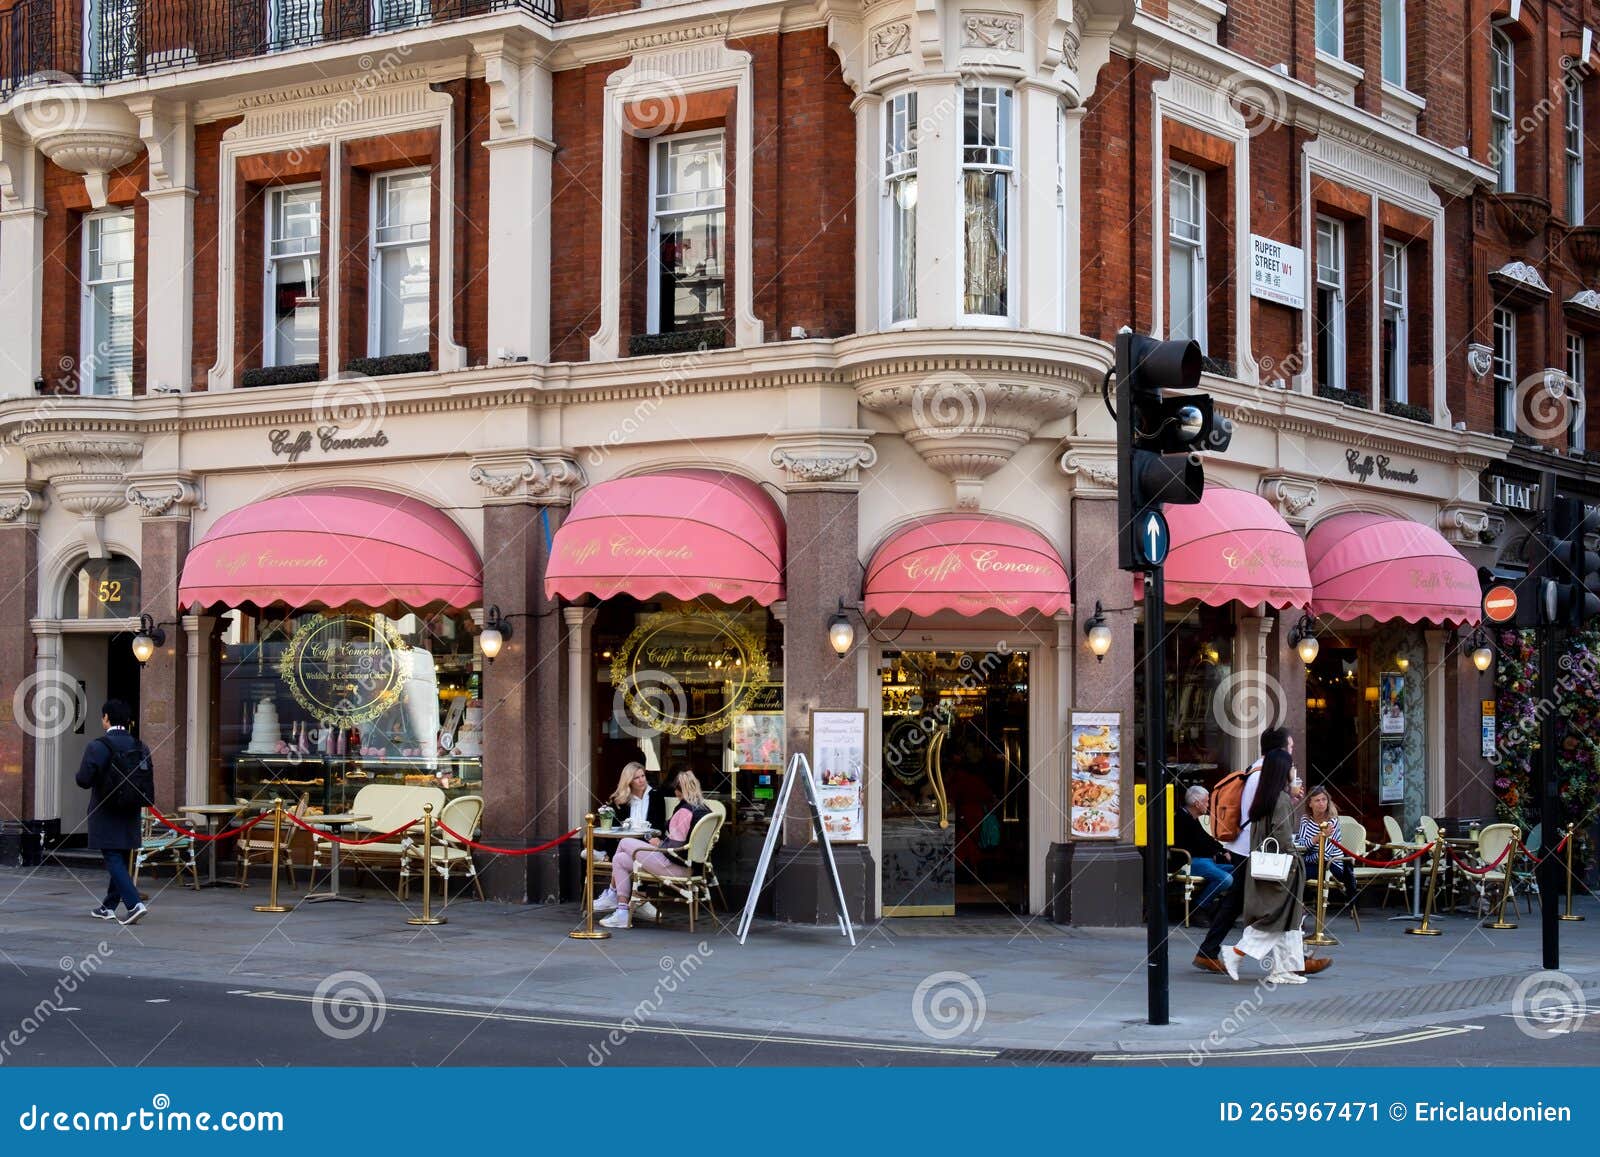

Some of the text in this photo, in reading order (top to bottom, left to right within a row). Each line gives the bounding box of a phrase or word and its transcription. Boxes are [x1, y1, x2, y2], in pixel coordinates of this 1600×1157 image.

[1255, 240, 1281, 258] RUPERT
[1255, 255, 1292, 276] STREET W1
[317, 425, 388, 453] Concerto
[1376, 455, 1419, 485] Concerto
[1492, 475, 1531, 510] THAI
[608, 532, 694, 560] Concerto
[99, 580, 121, 602] 52
[340, 640, 382, 657] Concerto
